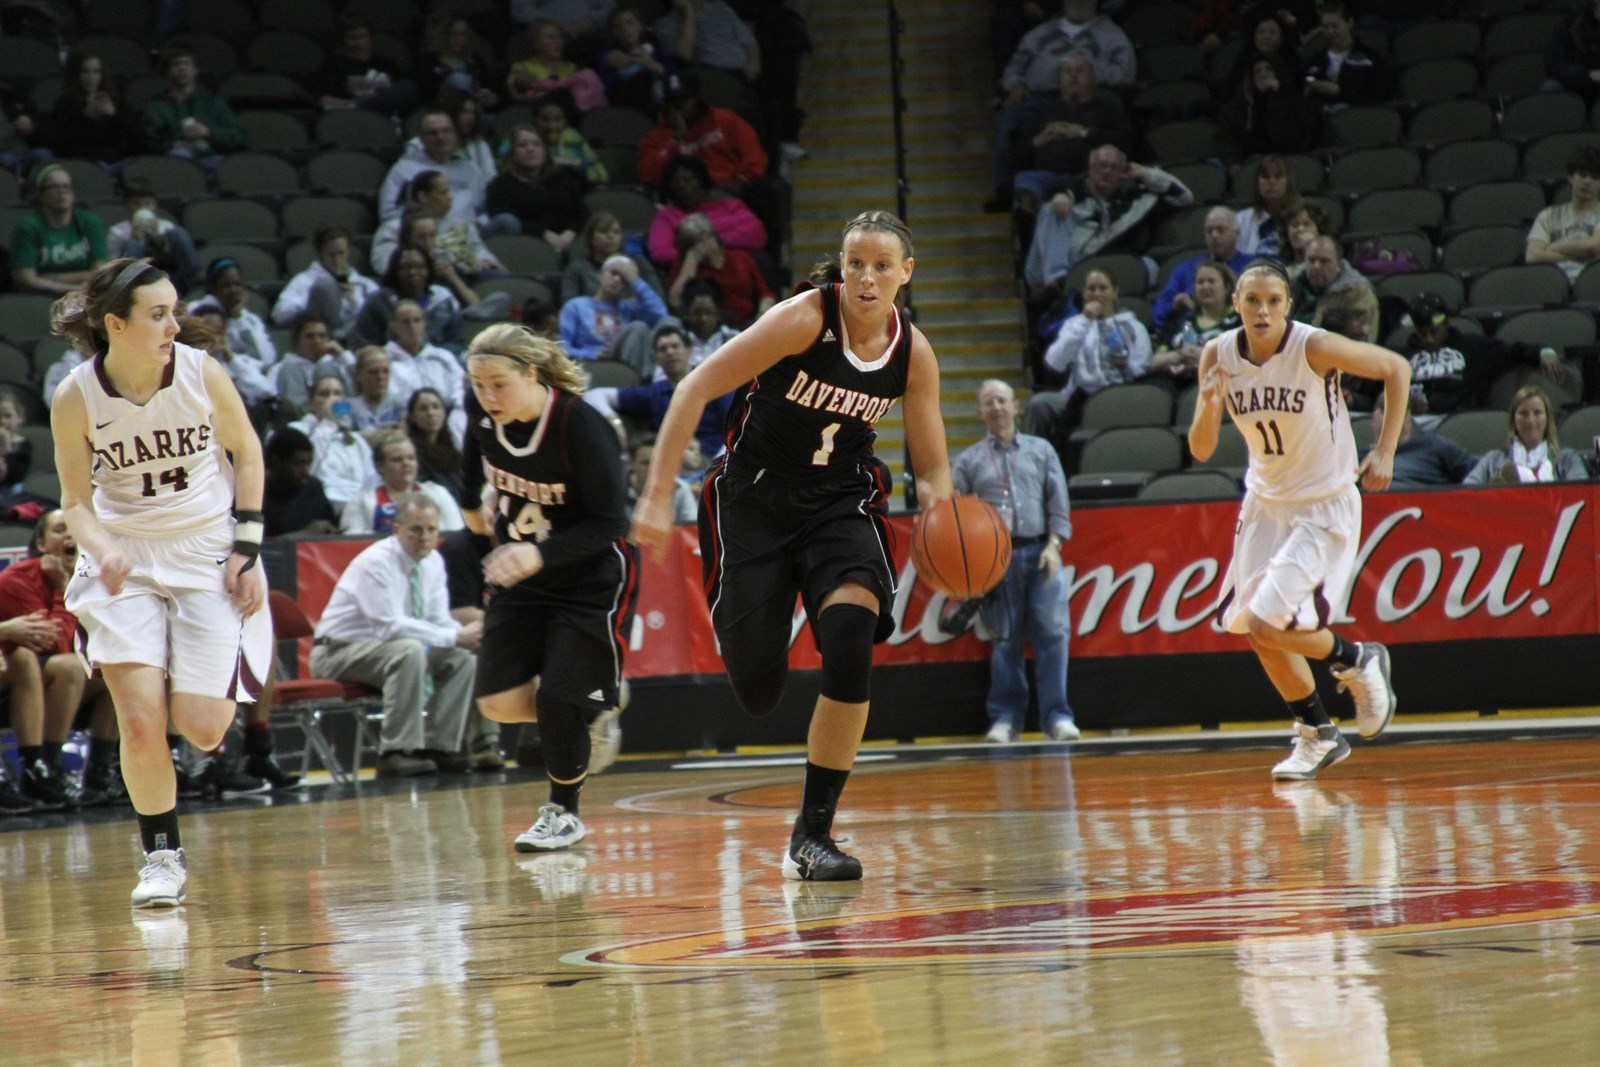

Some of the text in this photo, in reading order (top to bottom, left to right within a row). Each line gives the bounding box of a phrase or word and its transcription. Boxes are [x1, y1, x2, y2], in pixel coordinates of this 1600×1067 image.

[812, 422, 841, 466] 1
[1255, 419, 1285, 456] 11
[141, 466, 188, 497] 14
[1331, 500, 1586, 624] You!
